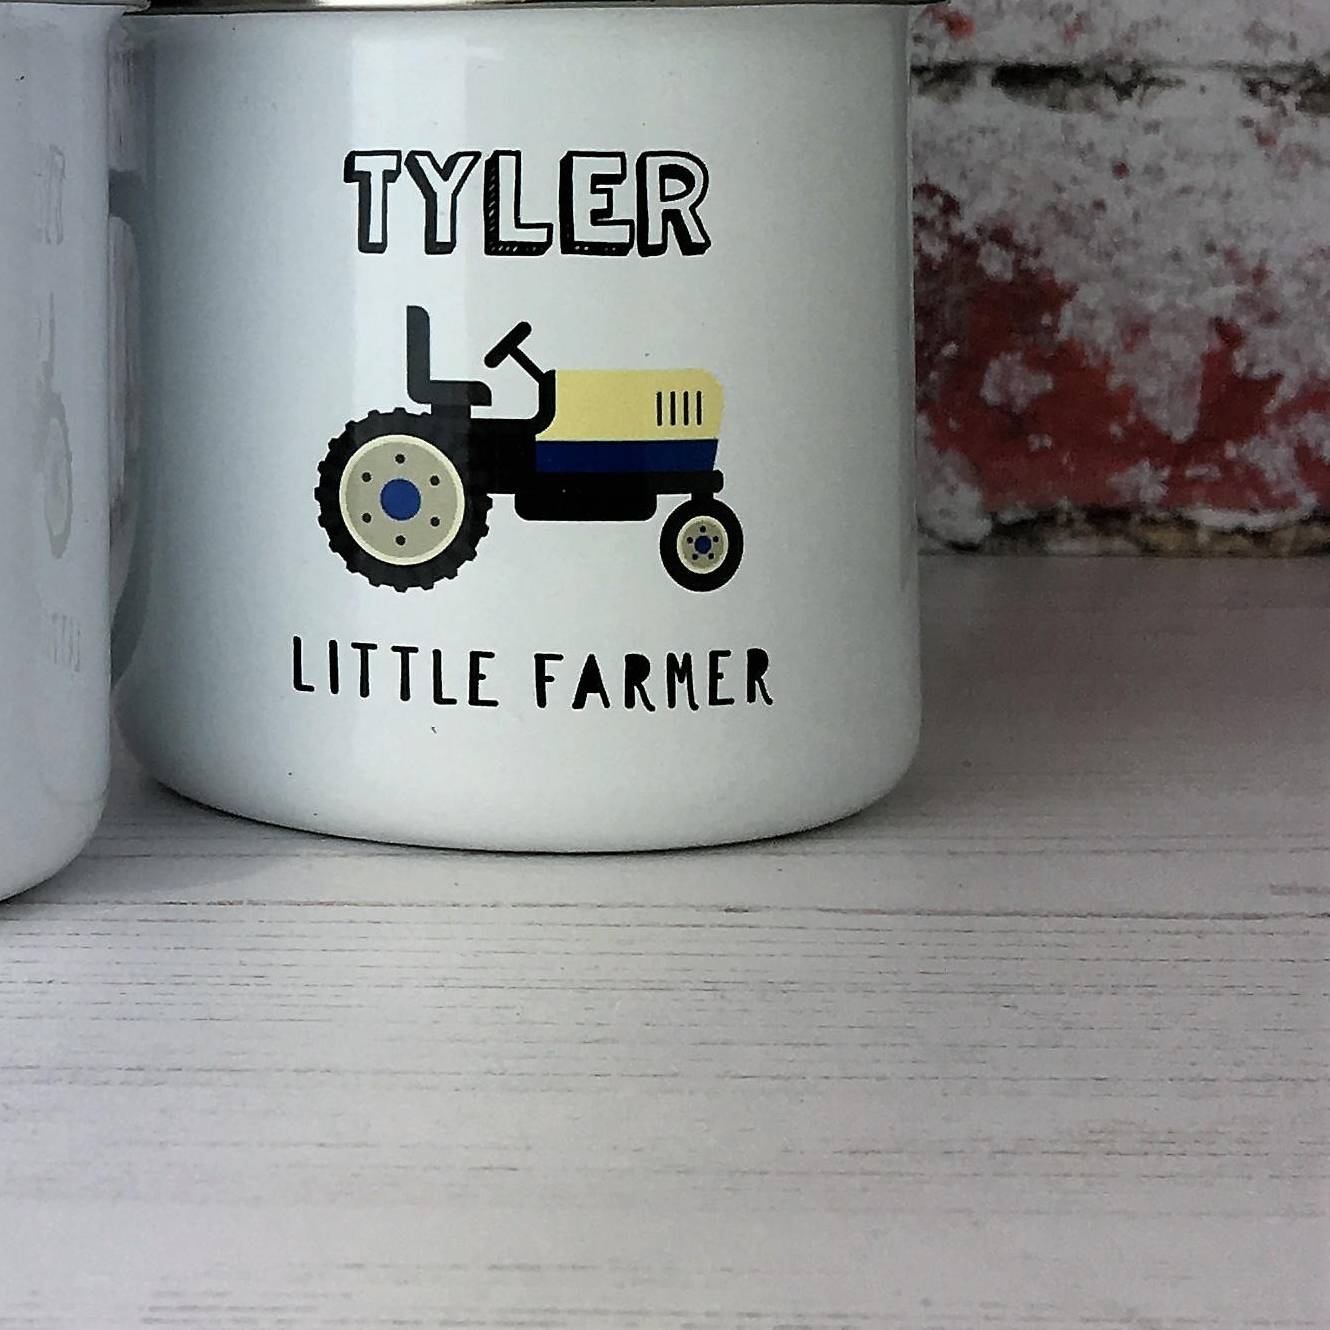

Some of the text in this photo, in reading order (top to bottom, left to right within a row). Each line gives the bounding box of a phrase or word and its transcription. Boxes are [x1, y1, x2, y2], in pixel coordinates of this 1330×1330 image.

[343, 149, 712, 258] TYLER
[292, 635, 774, 713] LITTLE FARMER
